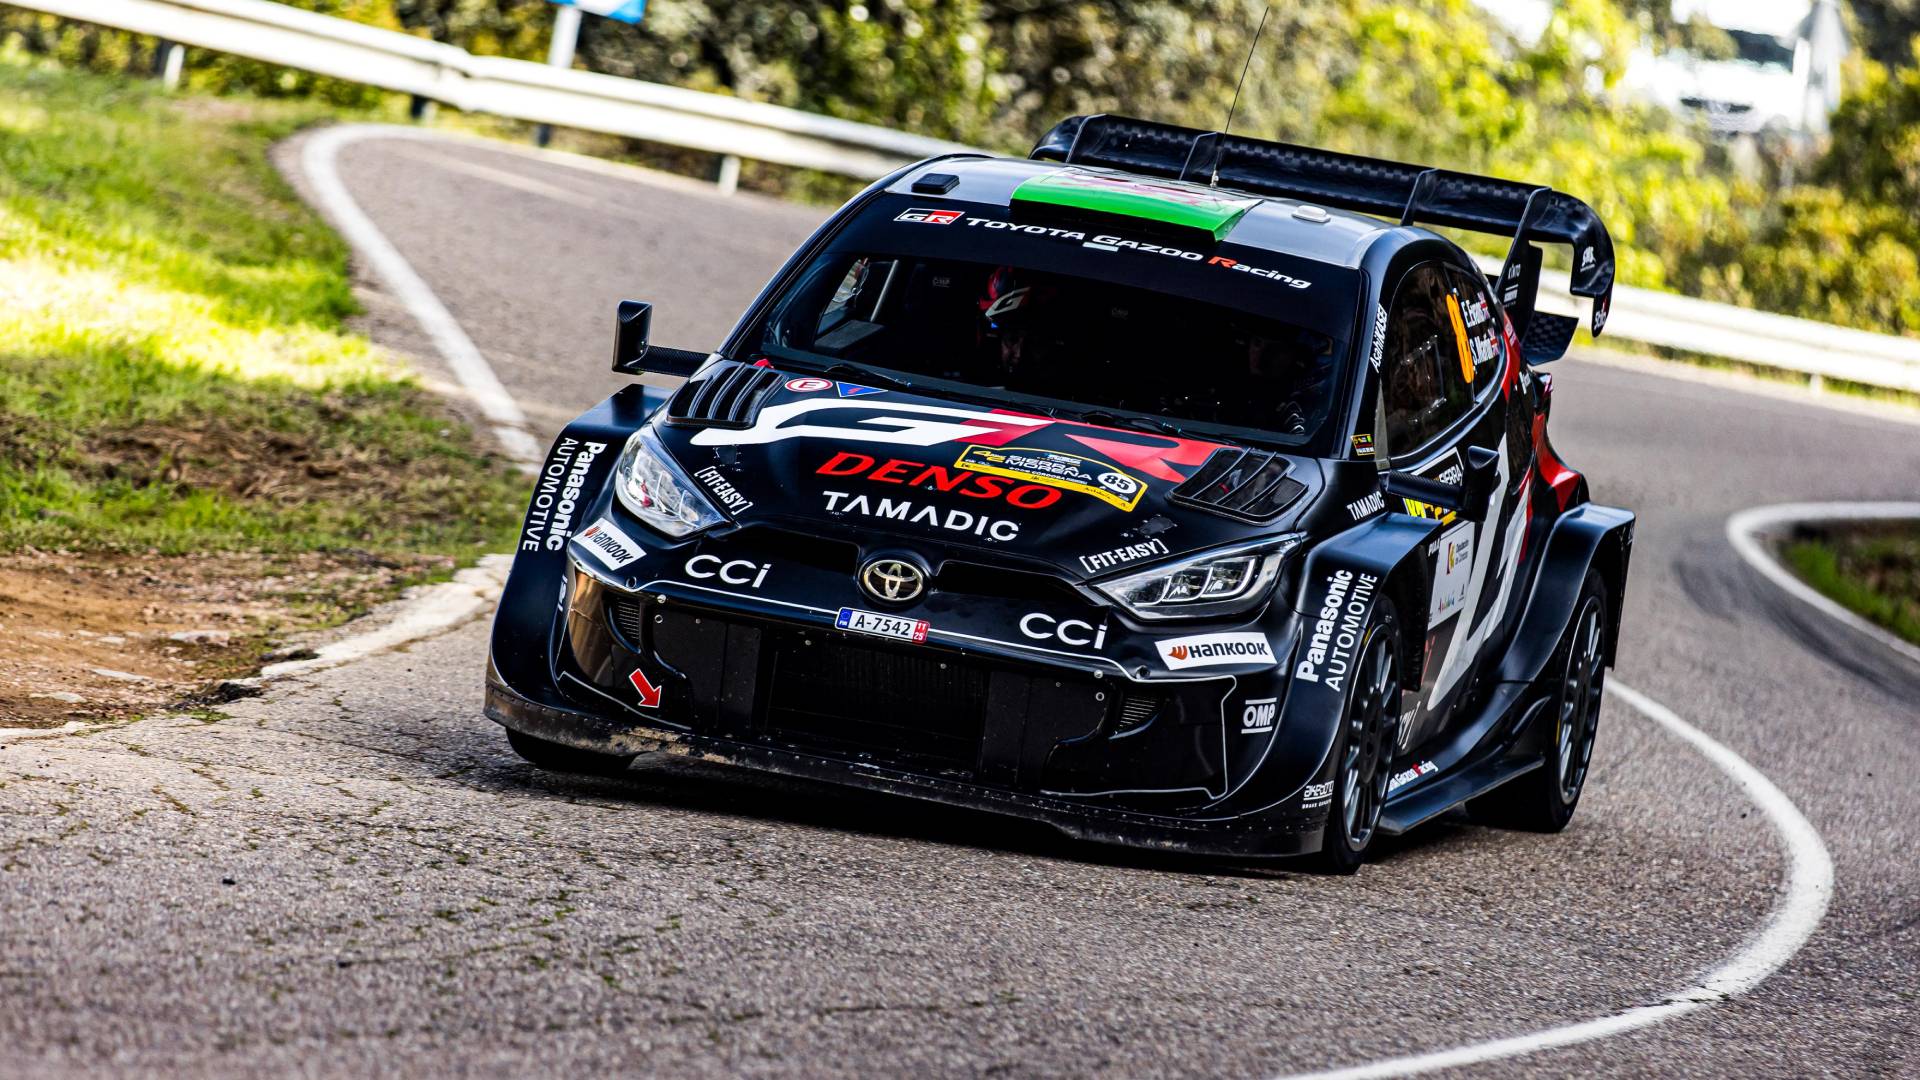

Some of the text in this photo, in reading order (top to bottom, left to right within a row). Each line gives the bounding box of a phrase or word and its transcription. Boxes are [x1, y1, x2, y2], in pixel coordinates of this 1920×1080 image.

[896, 211, 1313, 289] GR TOYOTA GAZOO Racing
[523, 437, 579, 552] AUTOMOTIVE
[816, 451, 1062, 510] DENSO
[1005, 458, 1092, 481] MORENA
[1103, 474, 1131, 491] 85
[546, 441, 607, 551] Panasonic
[823, 490, 1020, 541] TAMADIC
[1346, 490, 1386, 521] TAMADIC
[854, 614, 911, 637] A-7542
[913, 631, 924, 641] 25
[1296, 569, 1353, 682] Panasonic
[1325, 573, 1378, 692] AUTOMOTIVE
[1242, 702, 1276, 728] OMP
